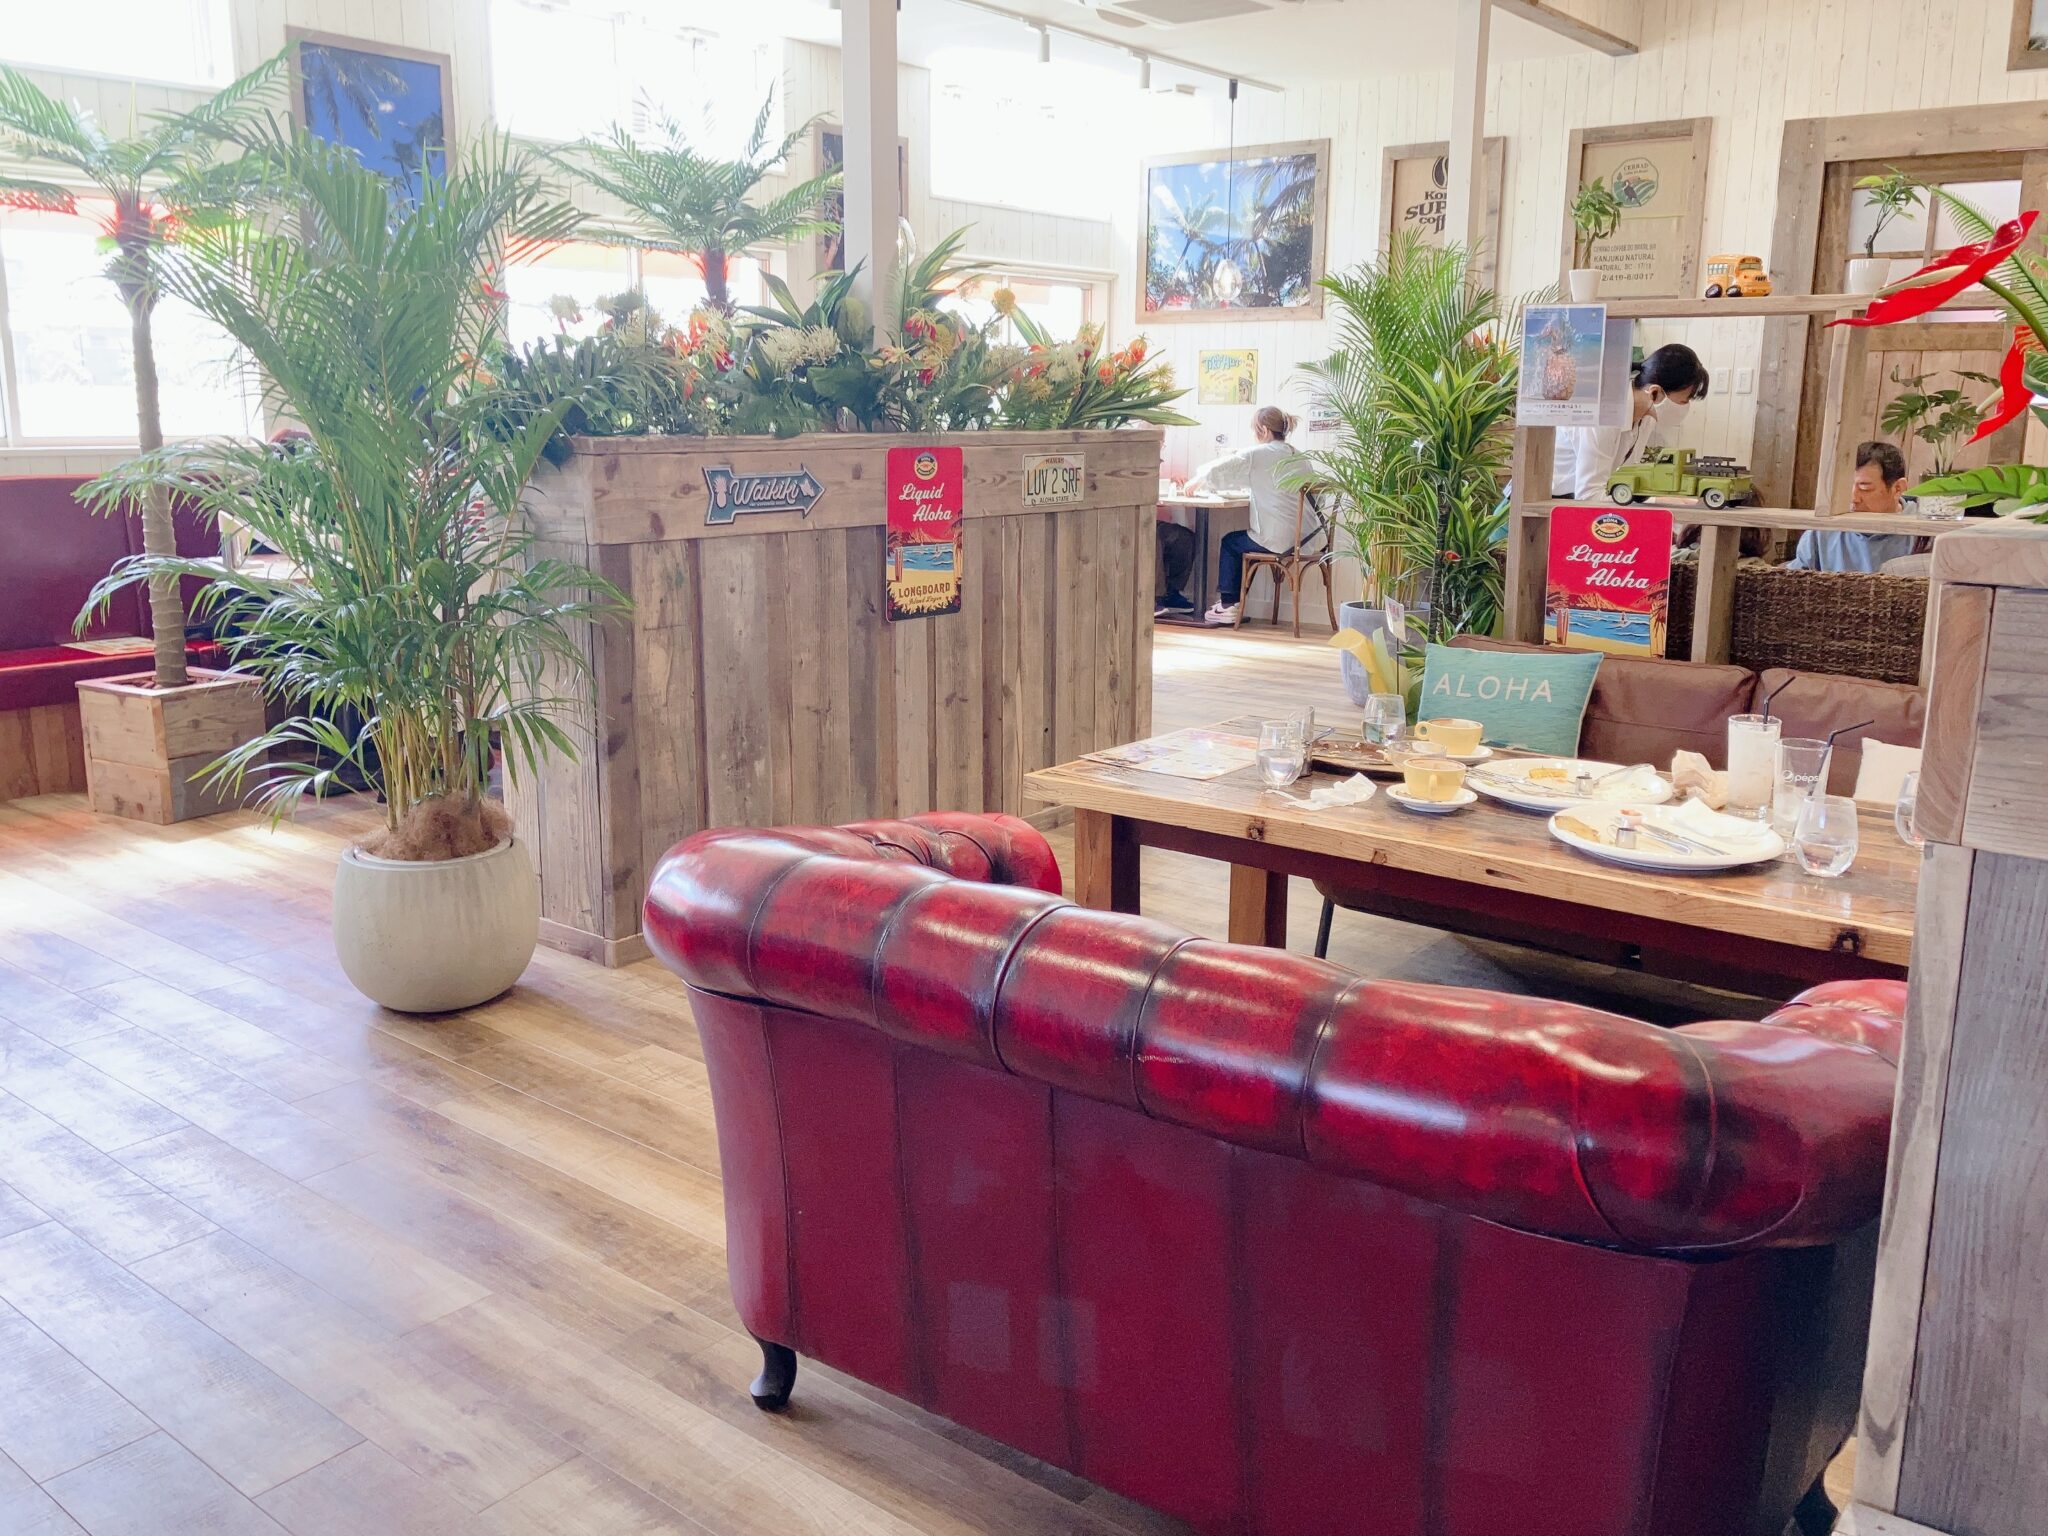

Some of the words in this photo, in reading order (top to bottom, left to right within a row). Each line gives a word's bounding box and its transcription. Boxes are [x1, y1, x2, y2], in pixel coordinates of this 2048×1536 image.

[1424, 191, 1447, 201] Ko
[1593, 254, 1625, 263] KANJUKU
[1625, 253, 1656, 261] NATURAL
[729, 478, 799, 505] Waikiki
[1027, 469, 1048, 496] LUV
[1051, 467, 1058, 494] 2
[1061, 467, 1082, 494] SRF
[899, 482, 945, 506] Liquid
[912, 503, 953, 522] Aloha
[1565, 543, 1640, 569] Liquid
[1585, 567, 1650, 589] Aloha
[898, 582, 951, 599] LONGBOARD
[1432, 672, 1552, 703] ALOHA
[1794, 774, 1820, 784] peps
